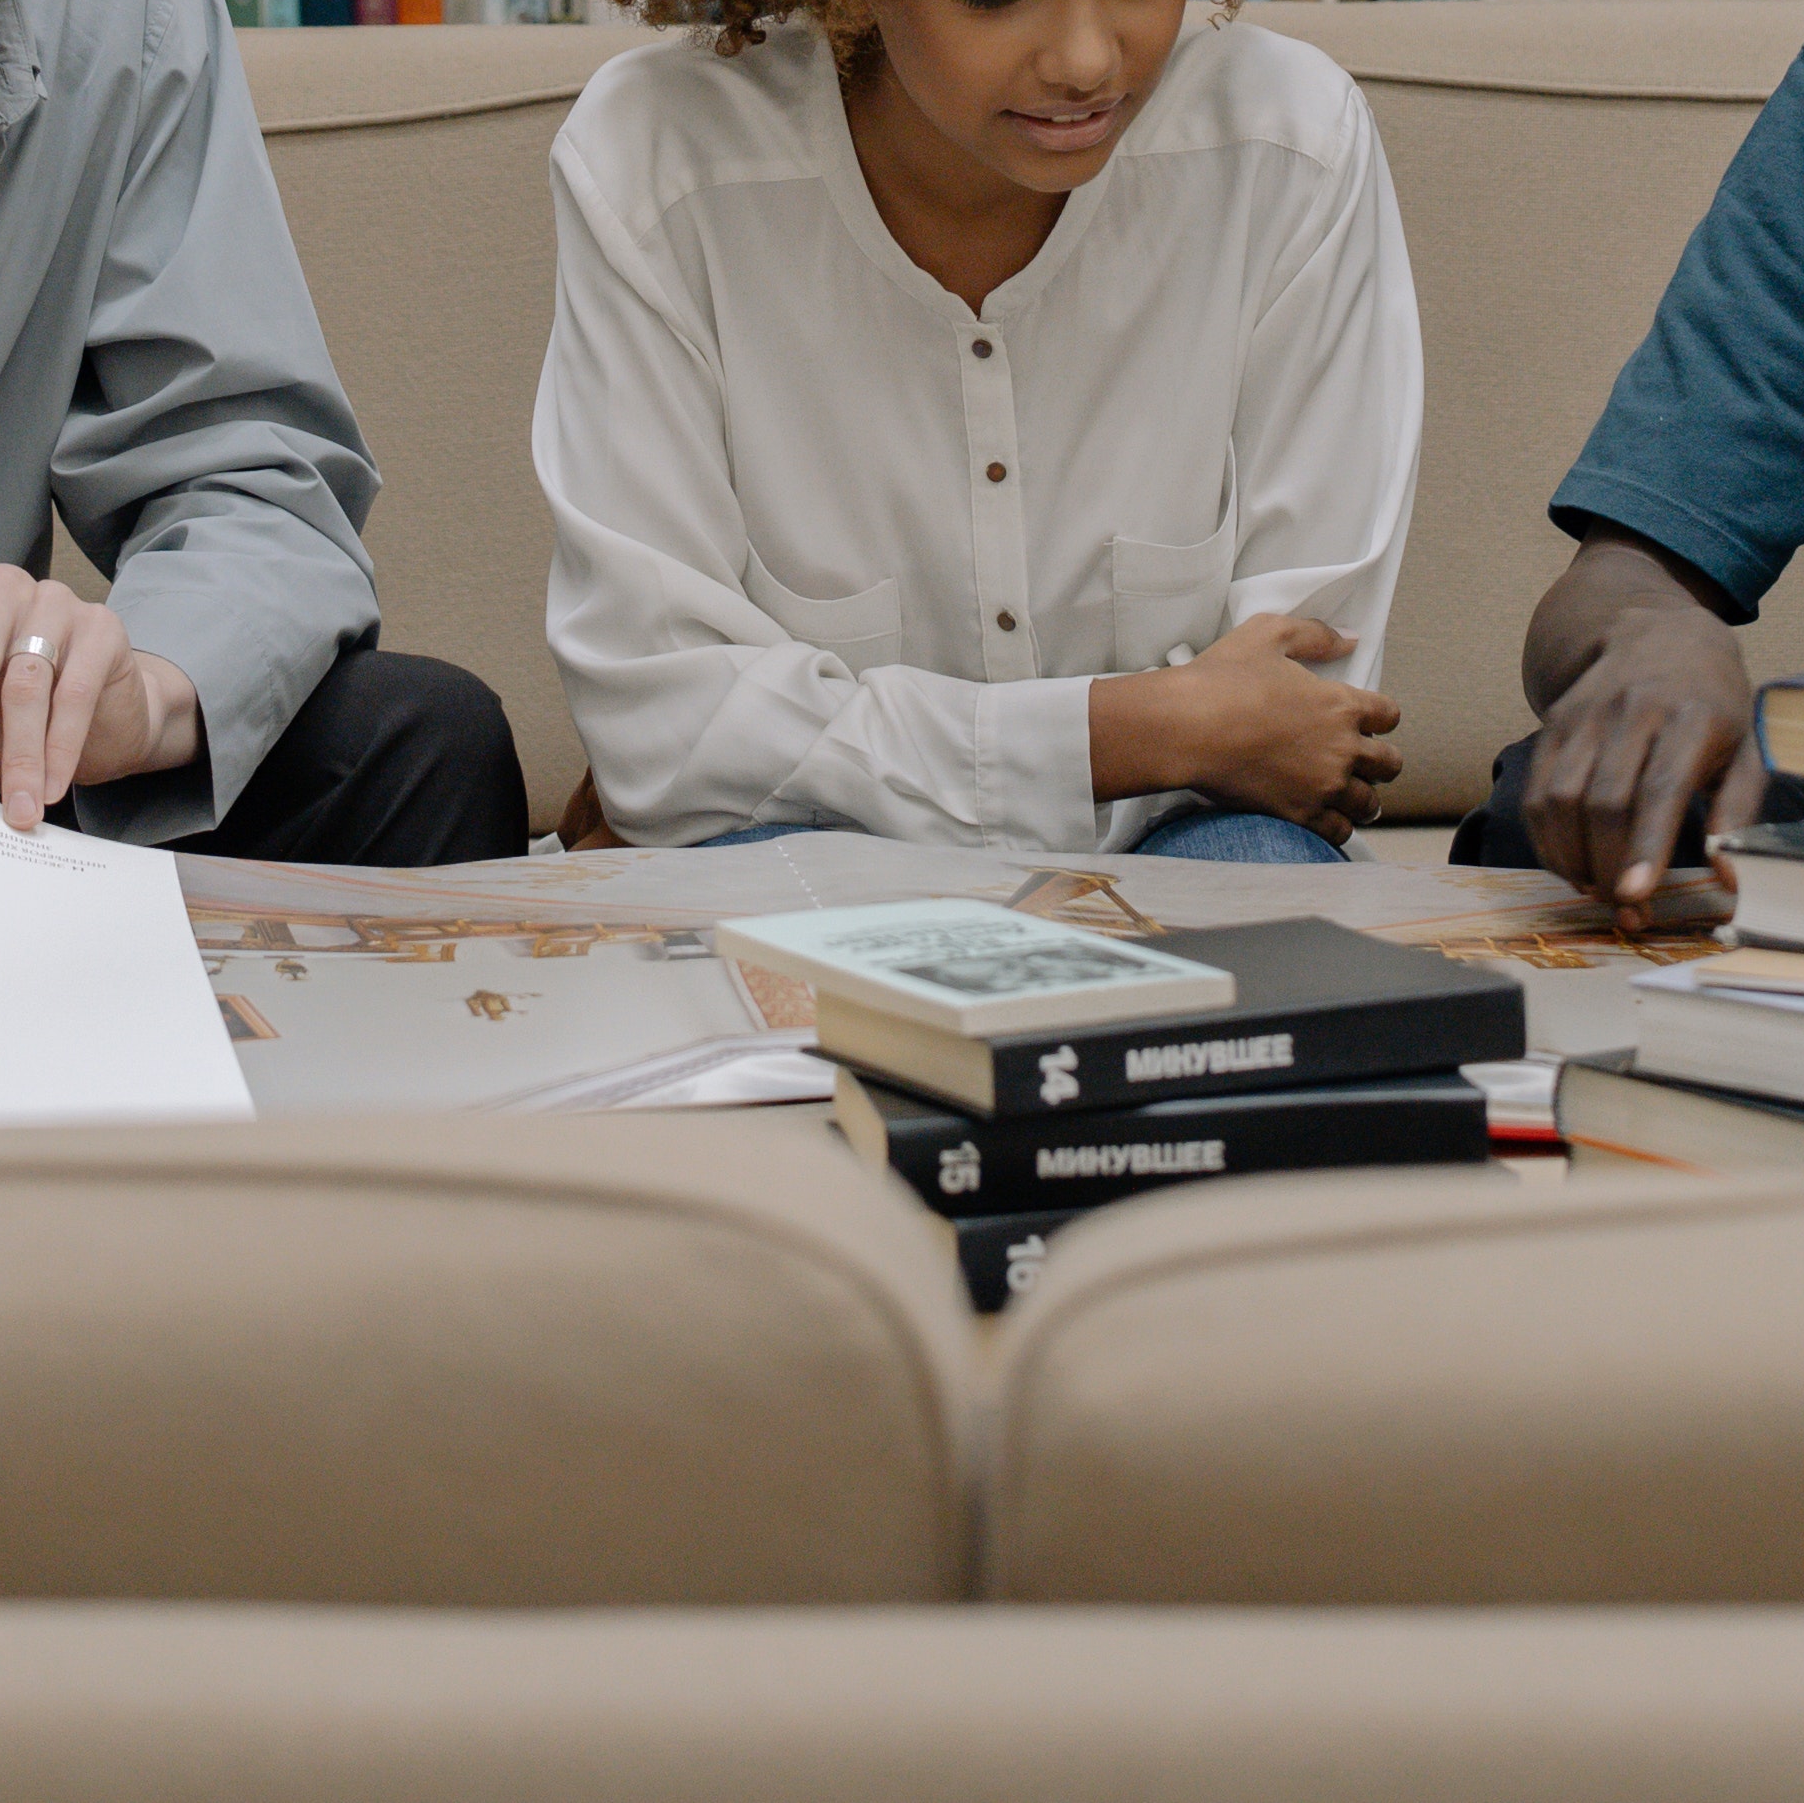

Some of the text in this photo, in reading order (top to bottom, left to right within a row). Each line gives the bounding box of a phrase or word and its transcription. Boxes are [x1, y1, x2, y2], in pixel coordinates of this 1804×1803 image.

[21, 846, 107, 869] ИНТЕРЬЕРОВ
[1038, 1043, 1080, 1107] 14
[1125, 1032, 1295, 1083] МИНУВШЕЕ
[938, 1139, 982, 1196] 15
[1035, 1138, 1227, 1179] МИНУВШЕЕ
[1005, 1233, 1048, 1293] 16
